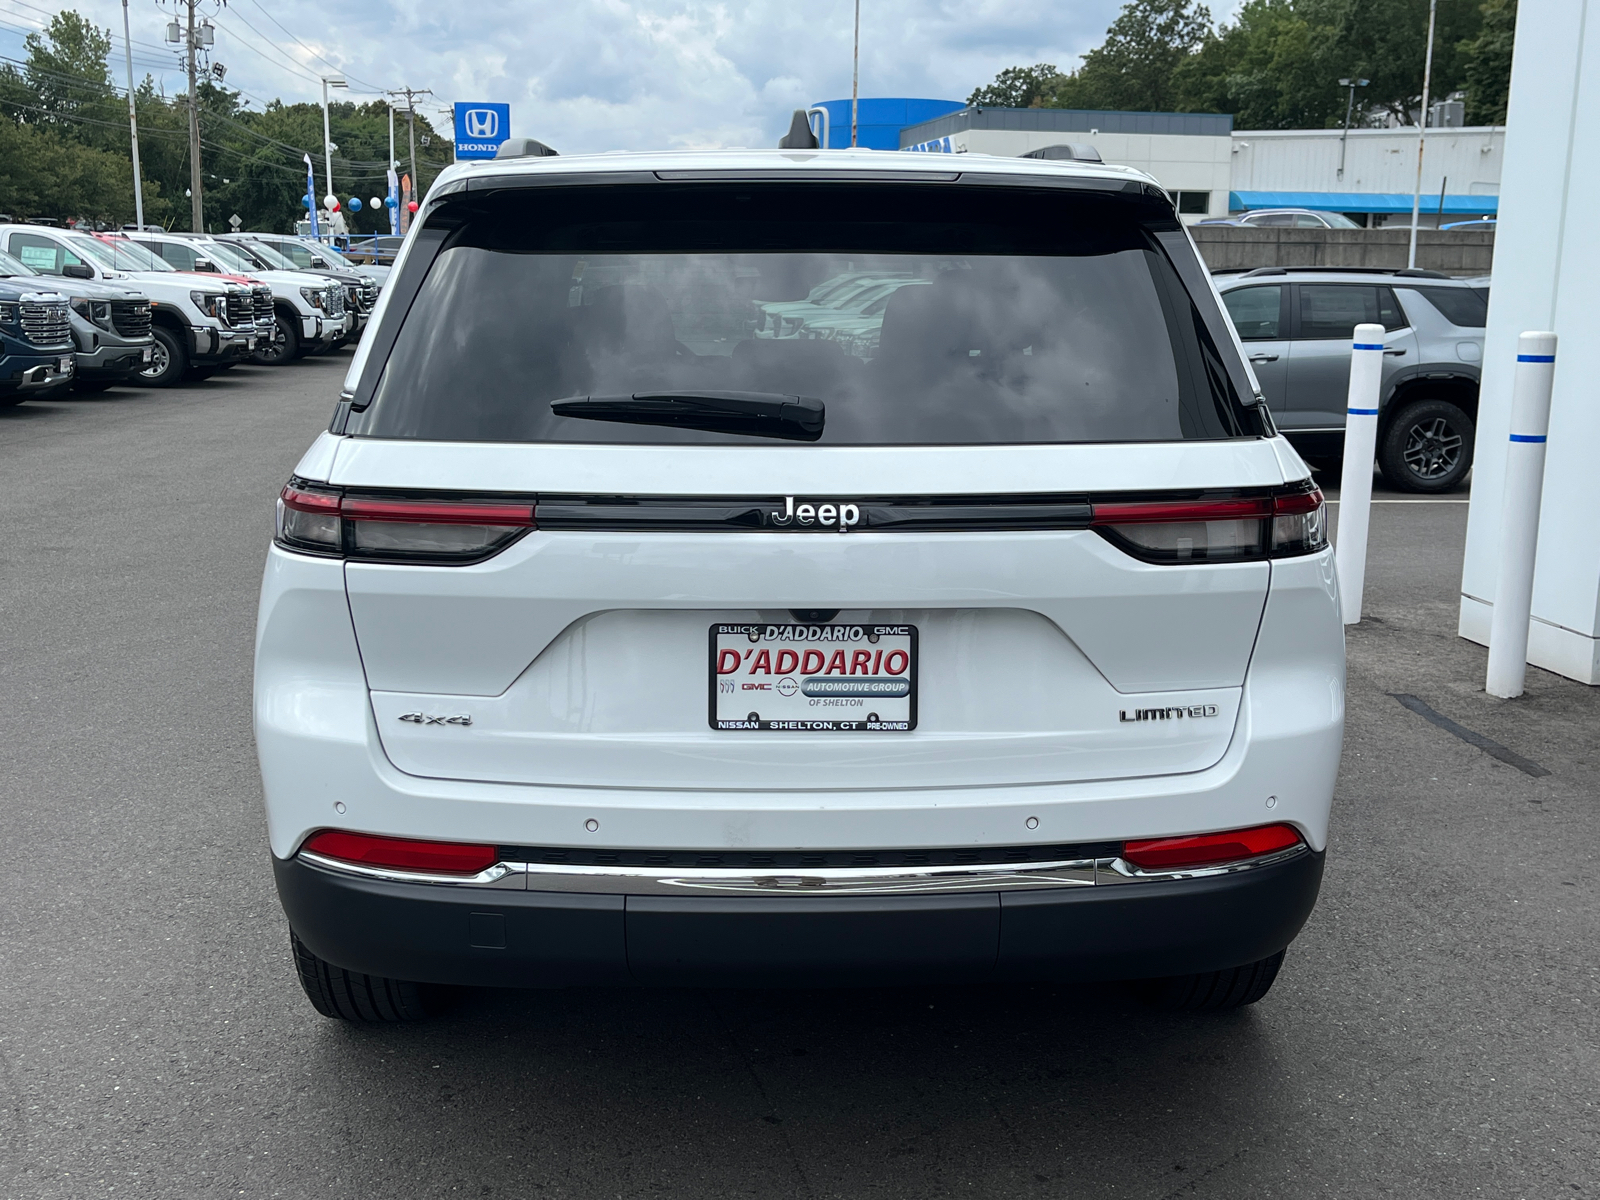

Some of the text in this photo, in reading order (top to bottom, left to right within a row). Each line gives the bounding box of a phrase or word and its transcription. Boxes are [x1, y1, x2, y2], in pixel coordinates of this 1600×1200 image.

[457, 143, 501, 152] HOND
[771, 496, 860, 533] Jeep
[719, 625, 909, 641] BUICK D'ADDARIO GMC
[716, 648, 909, 676] D'ADDARIO
[741, 683, 772, 691] GMC
[807, 682, 906, 692] AUTOMOTIVE GROUP
[808, 698, 864, 707] OF SHELTON
[1119, 704, 1220, 723] LIMITED
[718, 721, 909, 731] NISSAN SHELTON, CT PRE-OWNED
